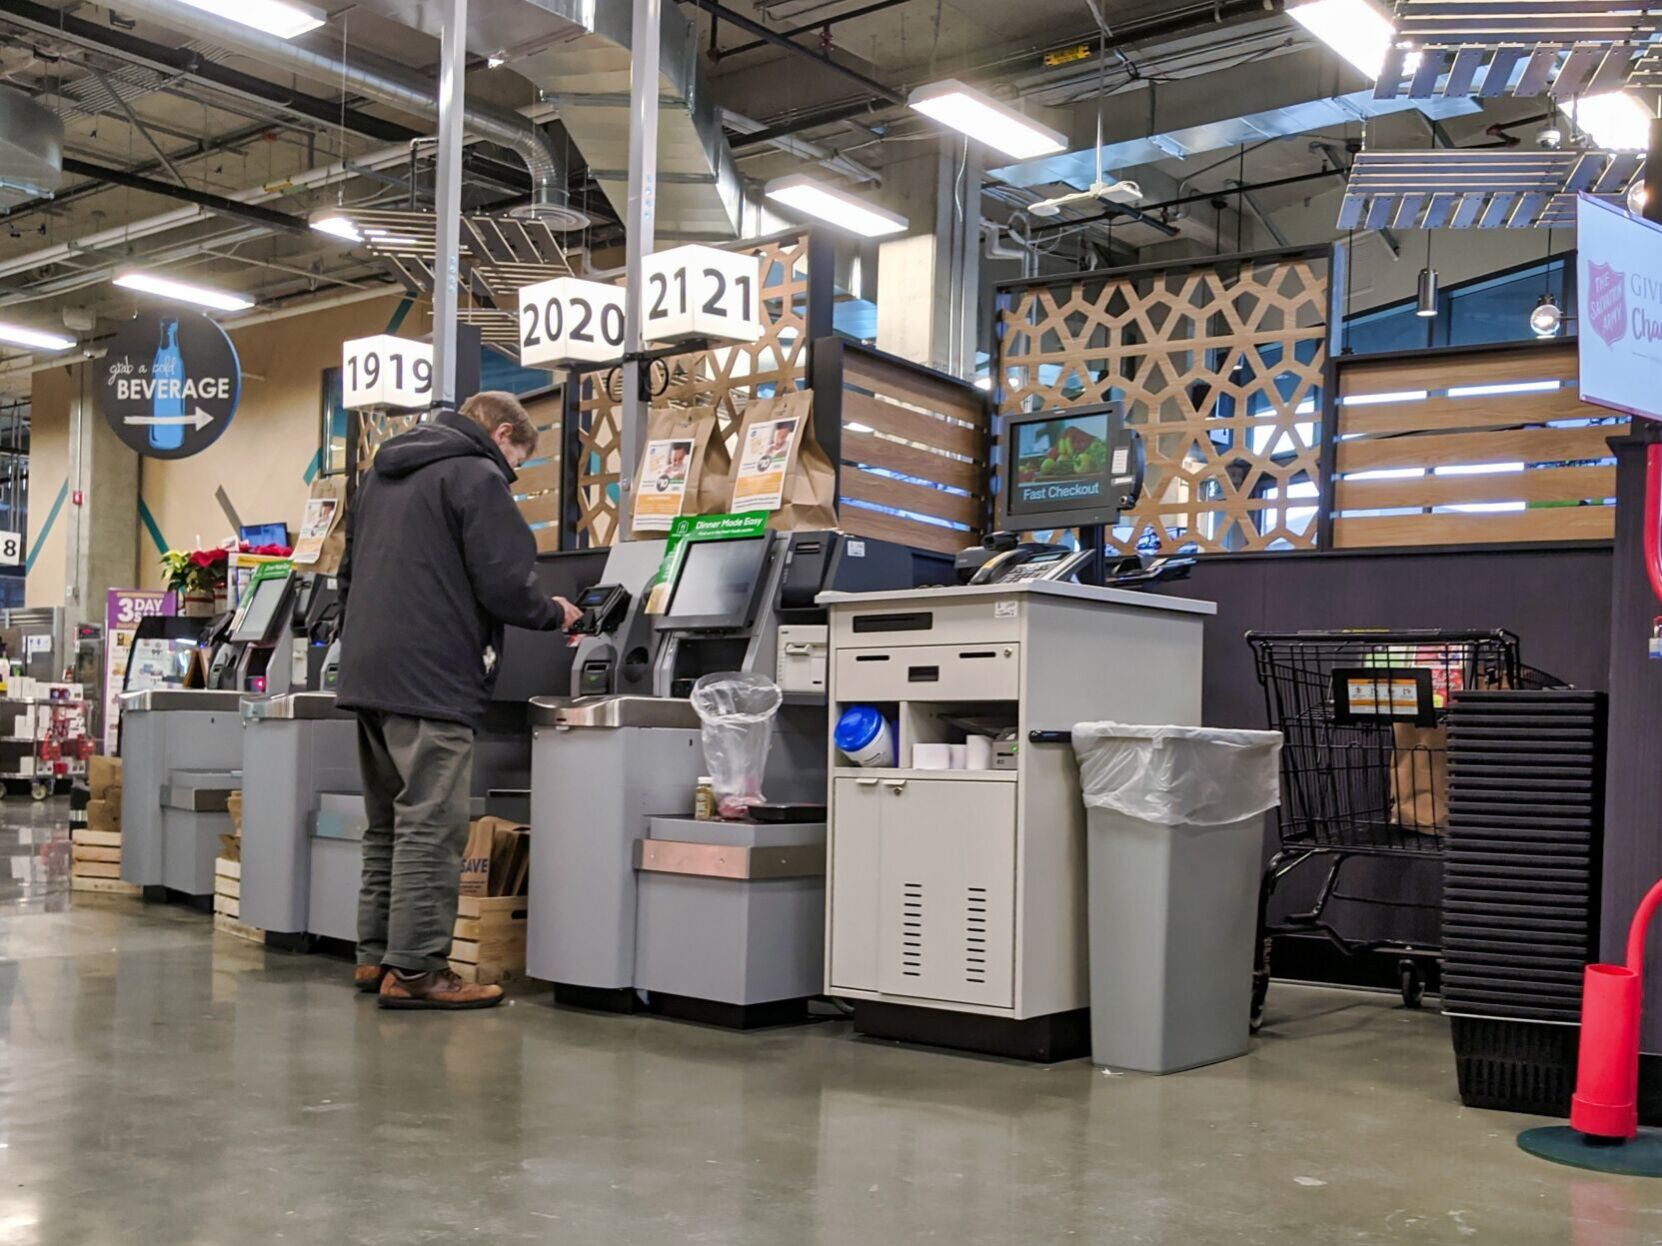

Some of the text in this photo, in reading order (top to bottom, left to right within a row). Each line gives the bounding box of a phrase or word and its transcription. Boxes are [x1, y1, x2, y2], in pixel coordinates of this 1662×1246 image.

[649, 267, 686, 320] 21
[703, 269, 751, 321] 21
[523, 297, 563, 347] 20
[569, 297, 625, 346] 20
[107, 355, 134, 386] grab
[138, 364, 148, 374] a
[348, 352, 380, 392] 19
[389, 353, 433, 394] 19
[117, 377, 230, 400] BEVERAGE
[1023, 482, 1099, 501] Fast Checkout
[695, 520, 721, 530] Dinner
[721, 517, 743, 528] Made
[744, 516, 764, 528] Easy
[3, 539, 17, 558] 8
[117, 597, 134, 624] 3
[134, 598, 164, 612] DAY
[460, 858, 489, 873] SAVE
